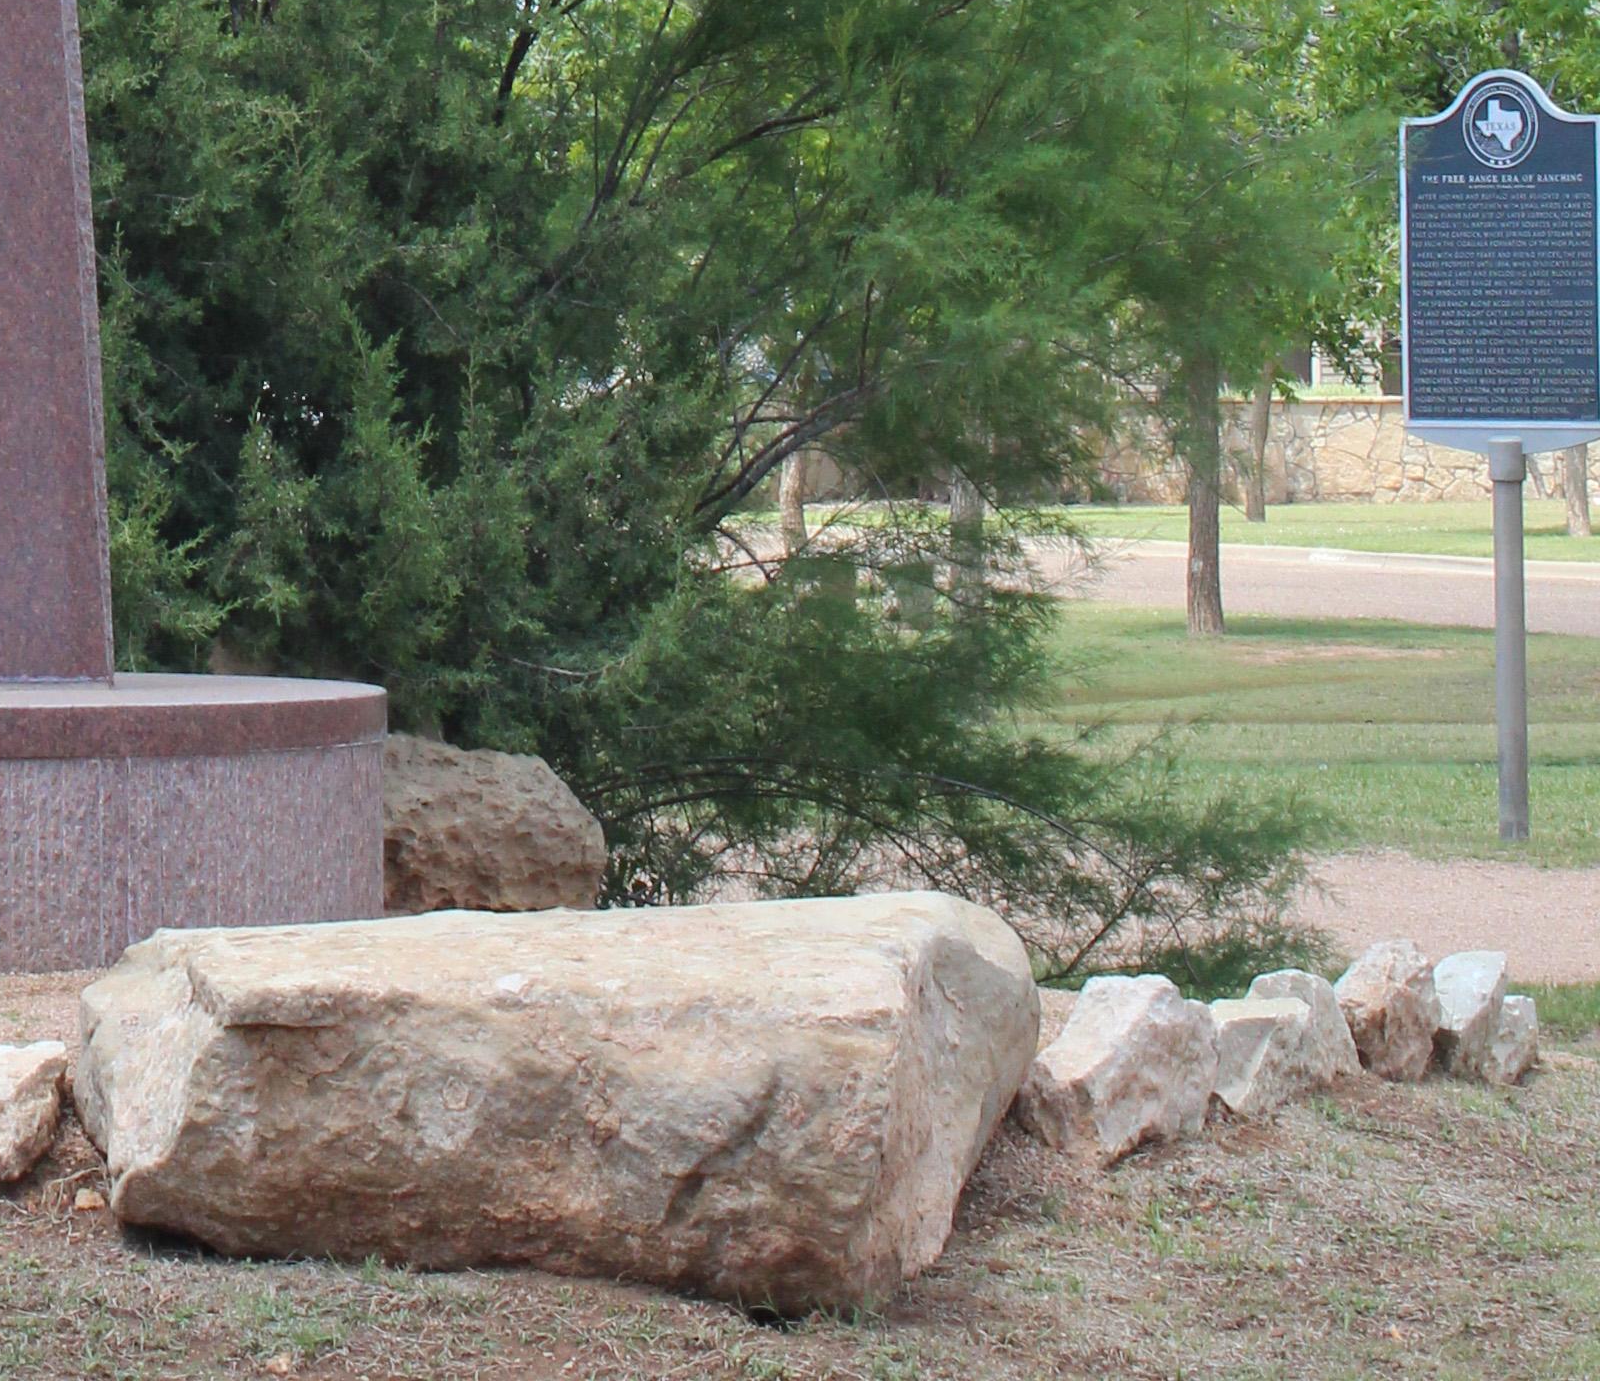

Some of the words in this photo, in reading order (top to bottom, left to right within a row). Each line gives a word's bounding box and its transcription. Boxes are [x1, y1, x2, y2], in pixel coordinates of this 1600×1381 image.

[1485, 122, 1516, 132] TEXAS
[1422, 174, 1438, 183] THE
[1442, 174, 1465, 183] FREE
[1469, 174, 1498, 183] RANGE
[1501, 174, 1519, 183] ERA
[1522, 174, 1534, 183] OF
[1537, 173, 1583, 183] RANCHING
